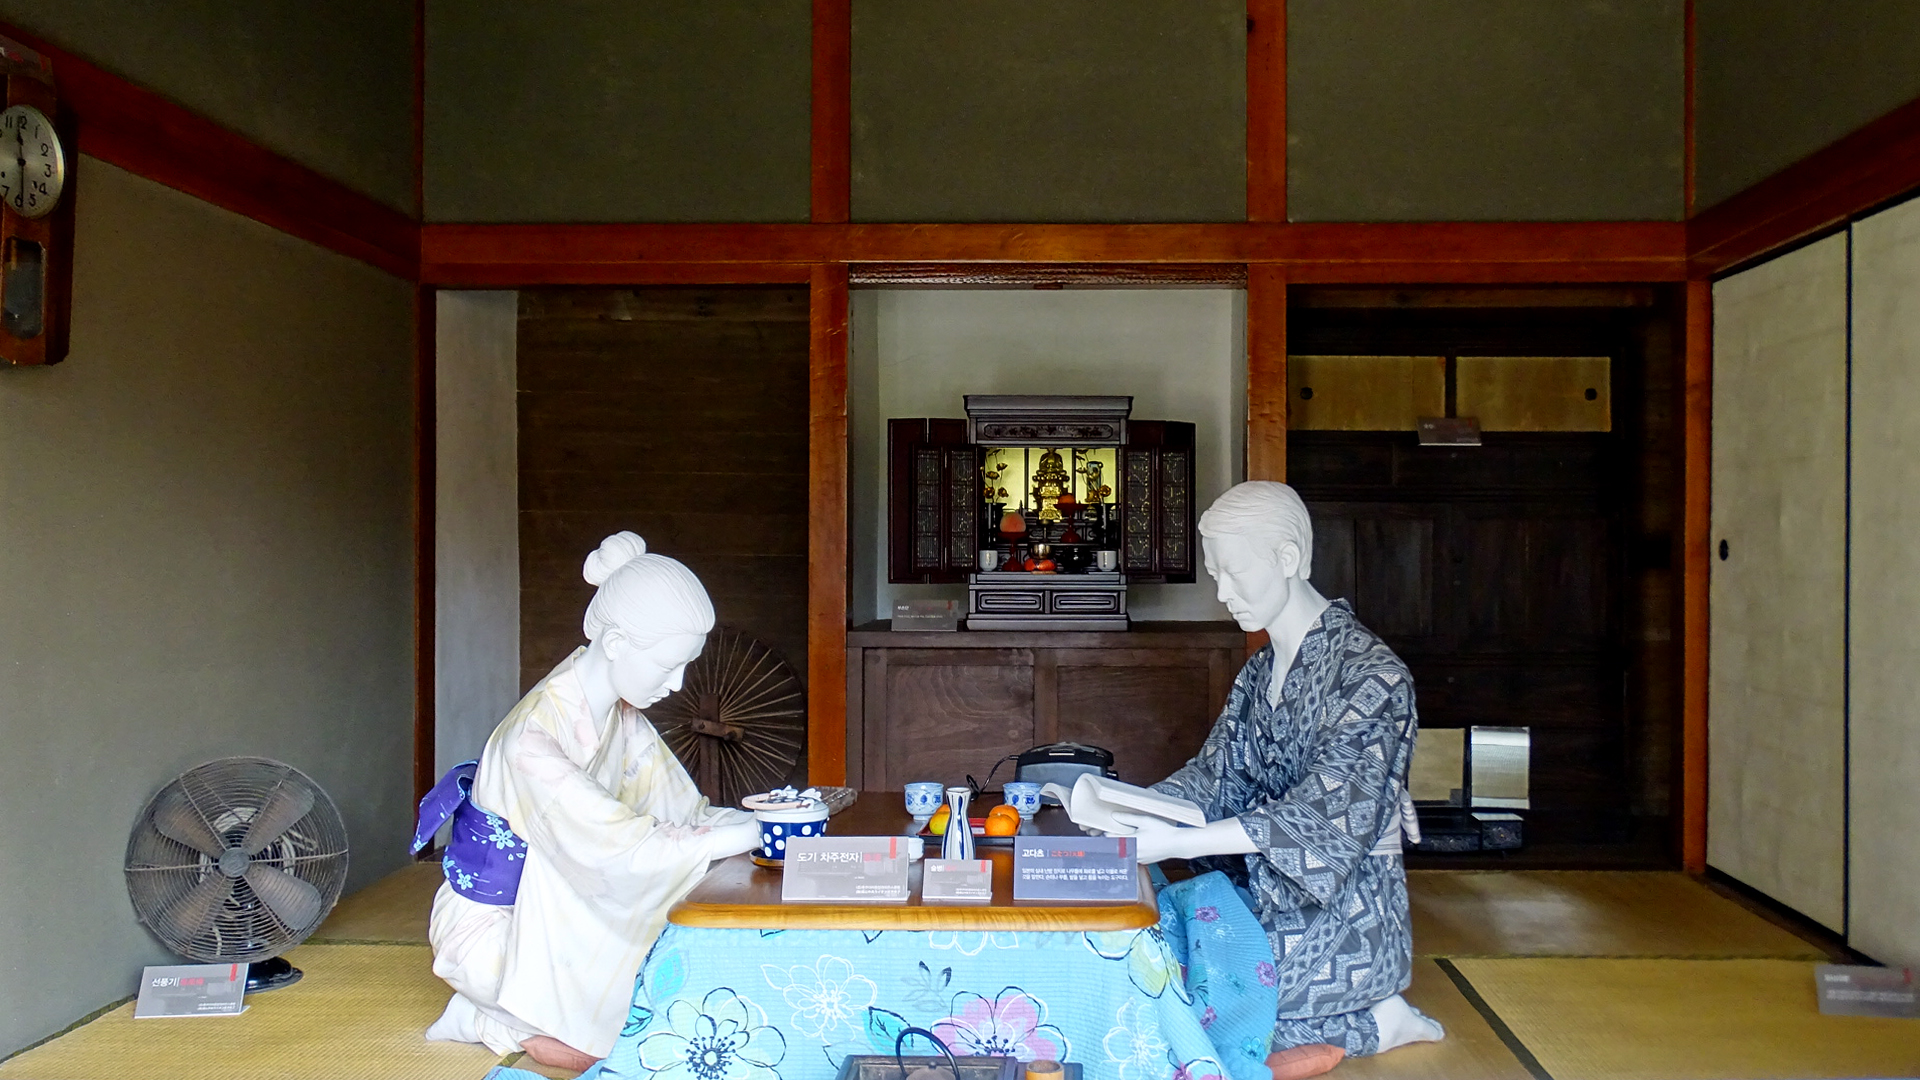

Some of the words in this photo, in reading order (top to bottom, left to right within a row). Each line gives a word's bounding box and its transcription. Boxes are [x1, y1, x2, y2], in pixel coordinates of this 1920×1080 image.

[41, 143, 48, 157] 2
[44, 164, 51, 178] 3
[39, 182, 48, 196] 4
[28, 193, 37, 207] 5
[797, 852, 817, 863] 도기
[820, 852, 859, 863] 차주전자
[1021, 848, 1045, 858] 고다츠
[152, 978, 177, 987] 선풍기
